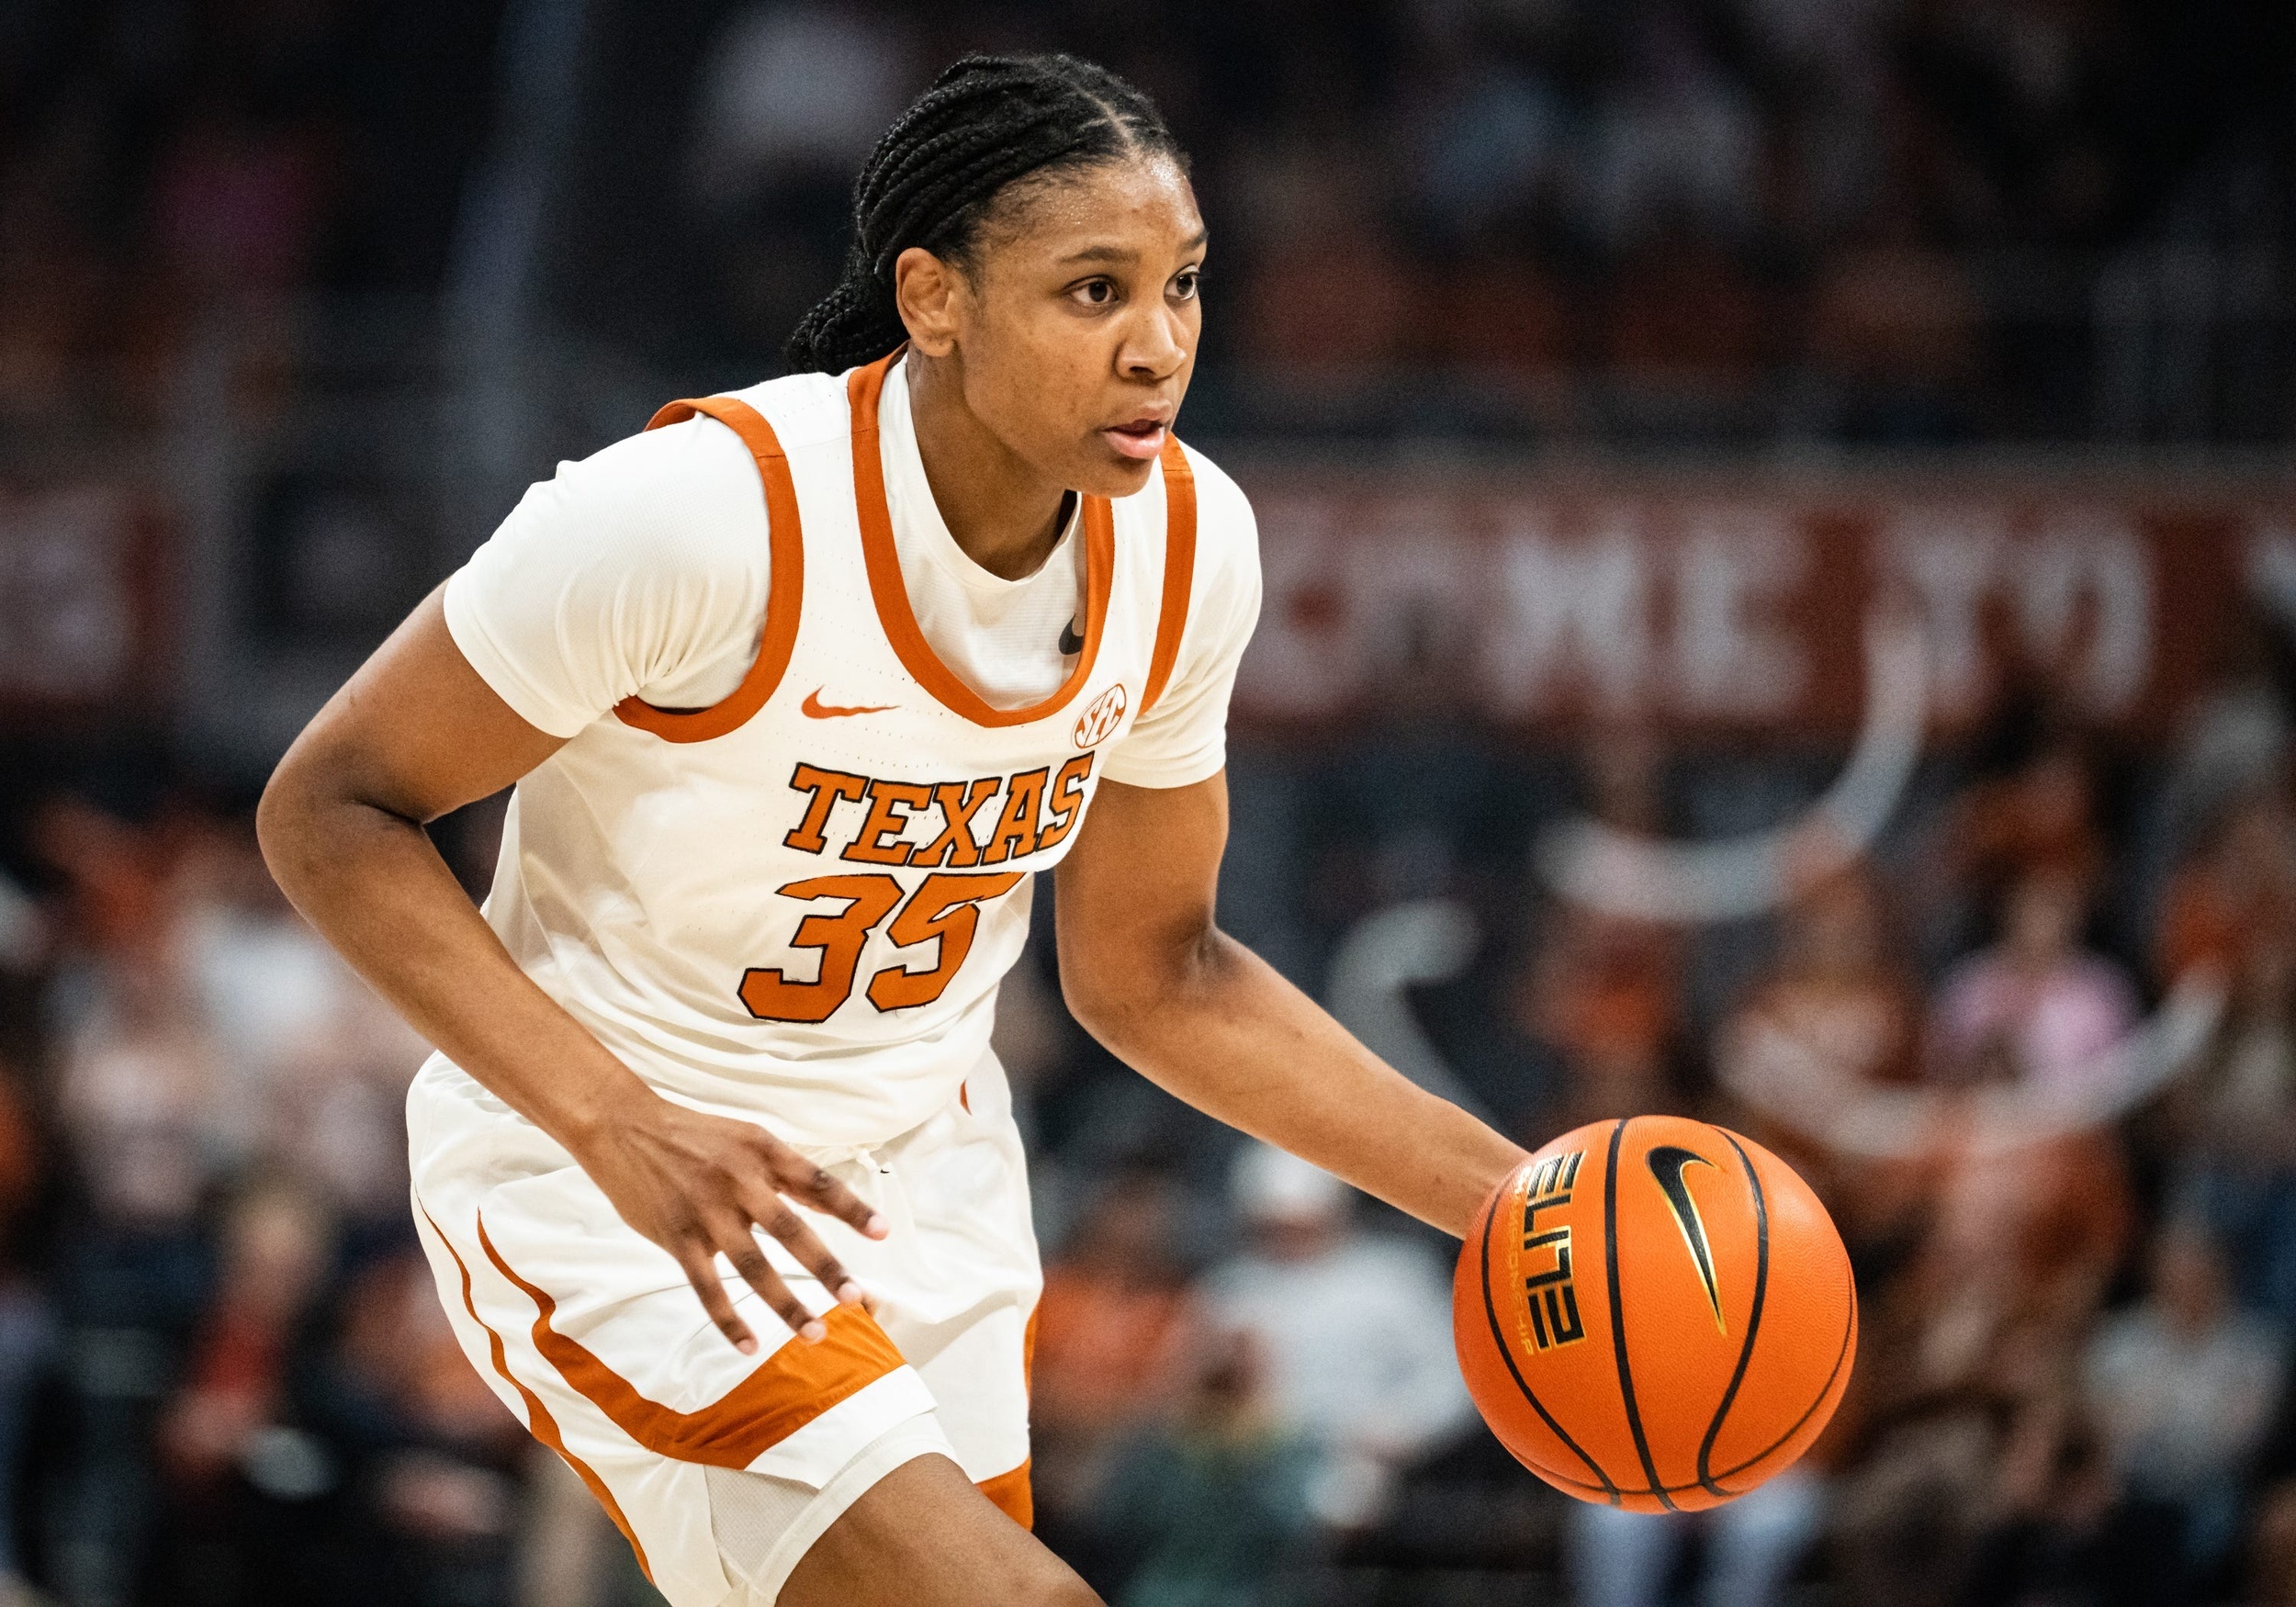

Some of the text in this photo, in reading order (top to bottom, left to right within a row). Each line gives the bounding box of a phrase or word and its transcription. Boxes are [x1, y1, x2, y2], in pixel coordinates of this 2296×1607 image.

[1074, 682, 1127, 749] SEC
[782, 750, 1096, 868] TEXAS
[737, 871, 1028, 1024] 35
[1523, 1148, 1587, 1352] ELITE
